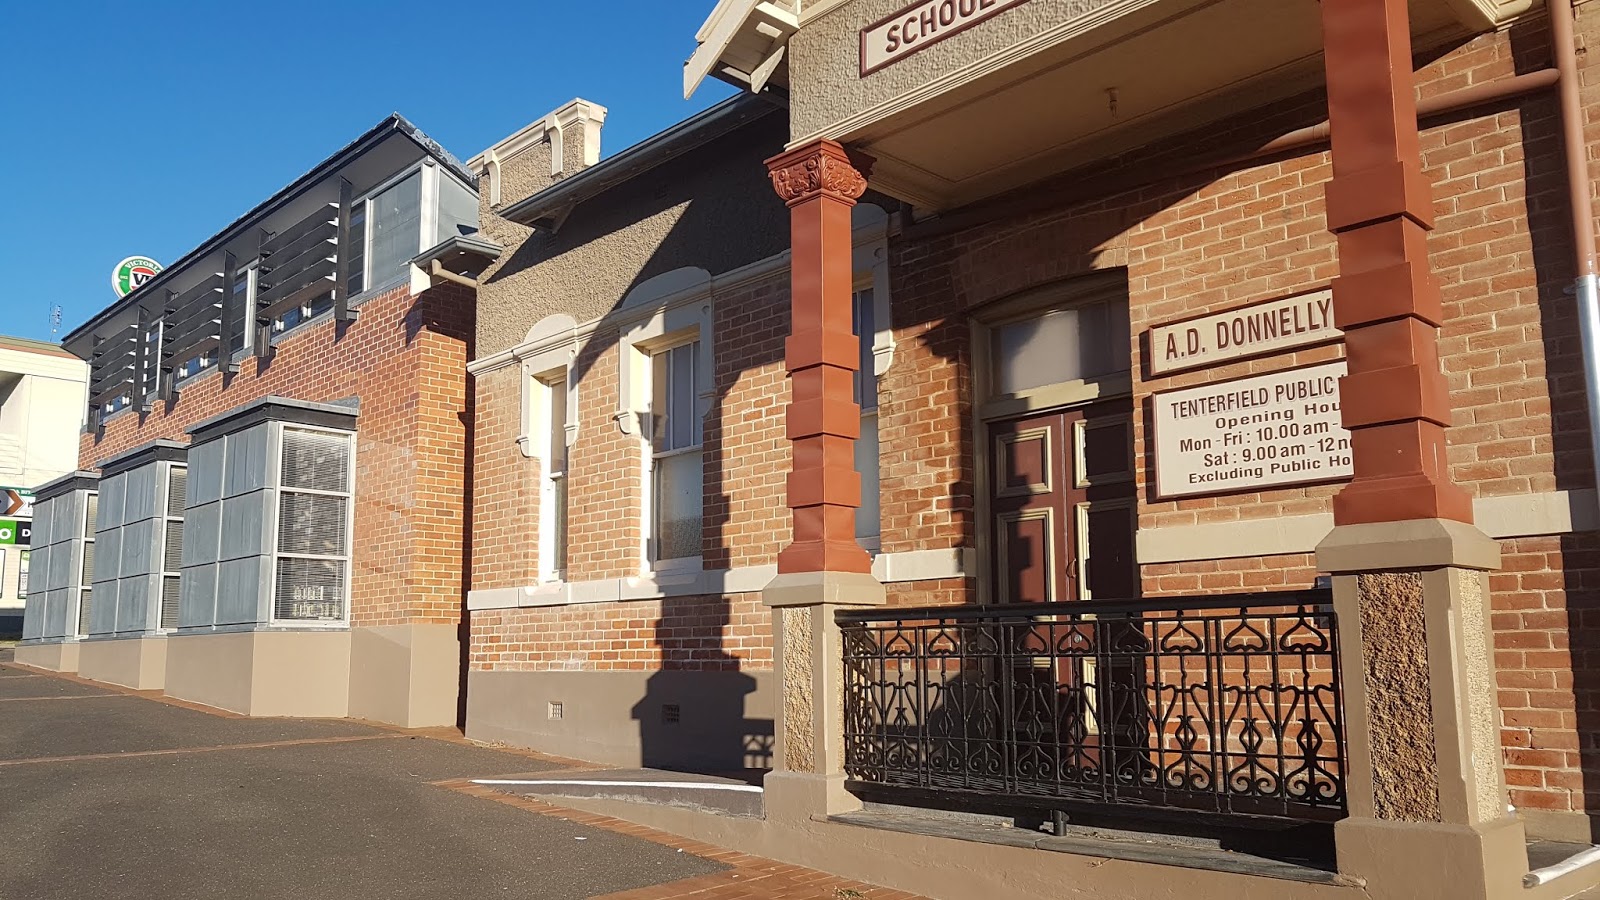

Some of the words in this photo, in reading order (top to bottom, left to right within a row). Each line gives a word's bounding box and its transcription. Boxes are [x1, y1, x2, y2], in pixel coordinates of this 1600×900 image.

[1166, 328, 1206, 361] A.D.
[1216, 298, 1331, 350] DONNELLY
[1171, 387, 1269, 419] TENTERFIELD
[1275, 376, 1335, 403] PUBLIC
[1215, 408, 1294, 430] Opening
[1180, 437, 1212, 453] Mon
[1224, 432, 1243, 447] Fri
[1256, 423, 1300, 442] 10.00
[1204, 452, 1229, 468] Sat
[1242, 445, 1277, 462] 9.00
[1280, 443, 1306, 458] am
[1189, 465, 1264, 484] Excluding
[1271, 458, 1321, 474] Public
